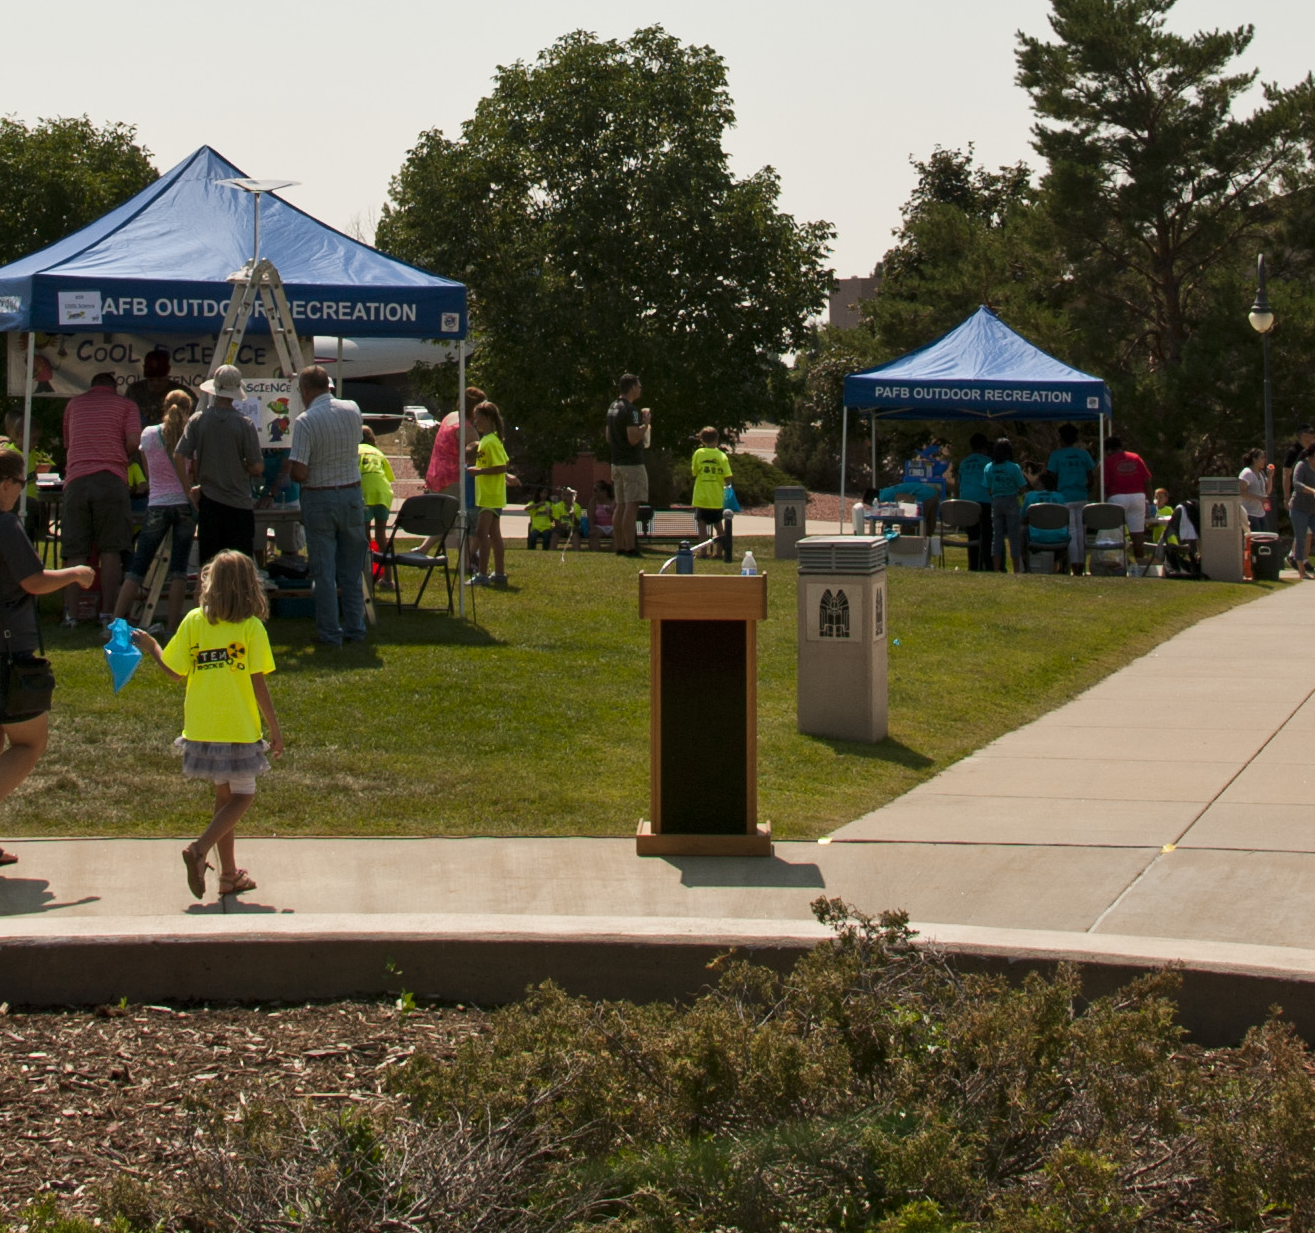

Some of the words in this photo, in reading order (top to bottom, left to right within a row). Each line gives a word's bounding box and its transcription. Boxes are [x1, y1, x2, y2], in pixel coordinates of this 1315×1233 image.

[102, 298, 148, 317] AFB
[277, 301, 416, 322] ECREATION
[155, 343, 266, 365] SCIECE
[246, 383, 291, 393] SCIENCE
[875, 386, 910, 398] PAFB
[913, 387, 981, 400] OUTDOOR
[985, 389, 1072, 403] RECREATION
[201, 651, 227, 661] TEM
